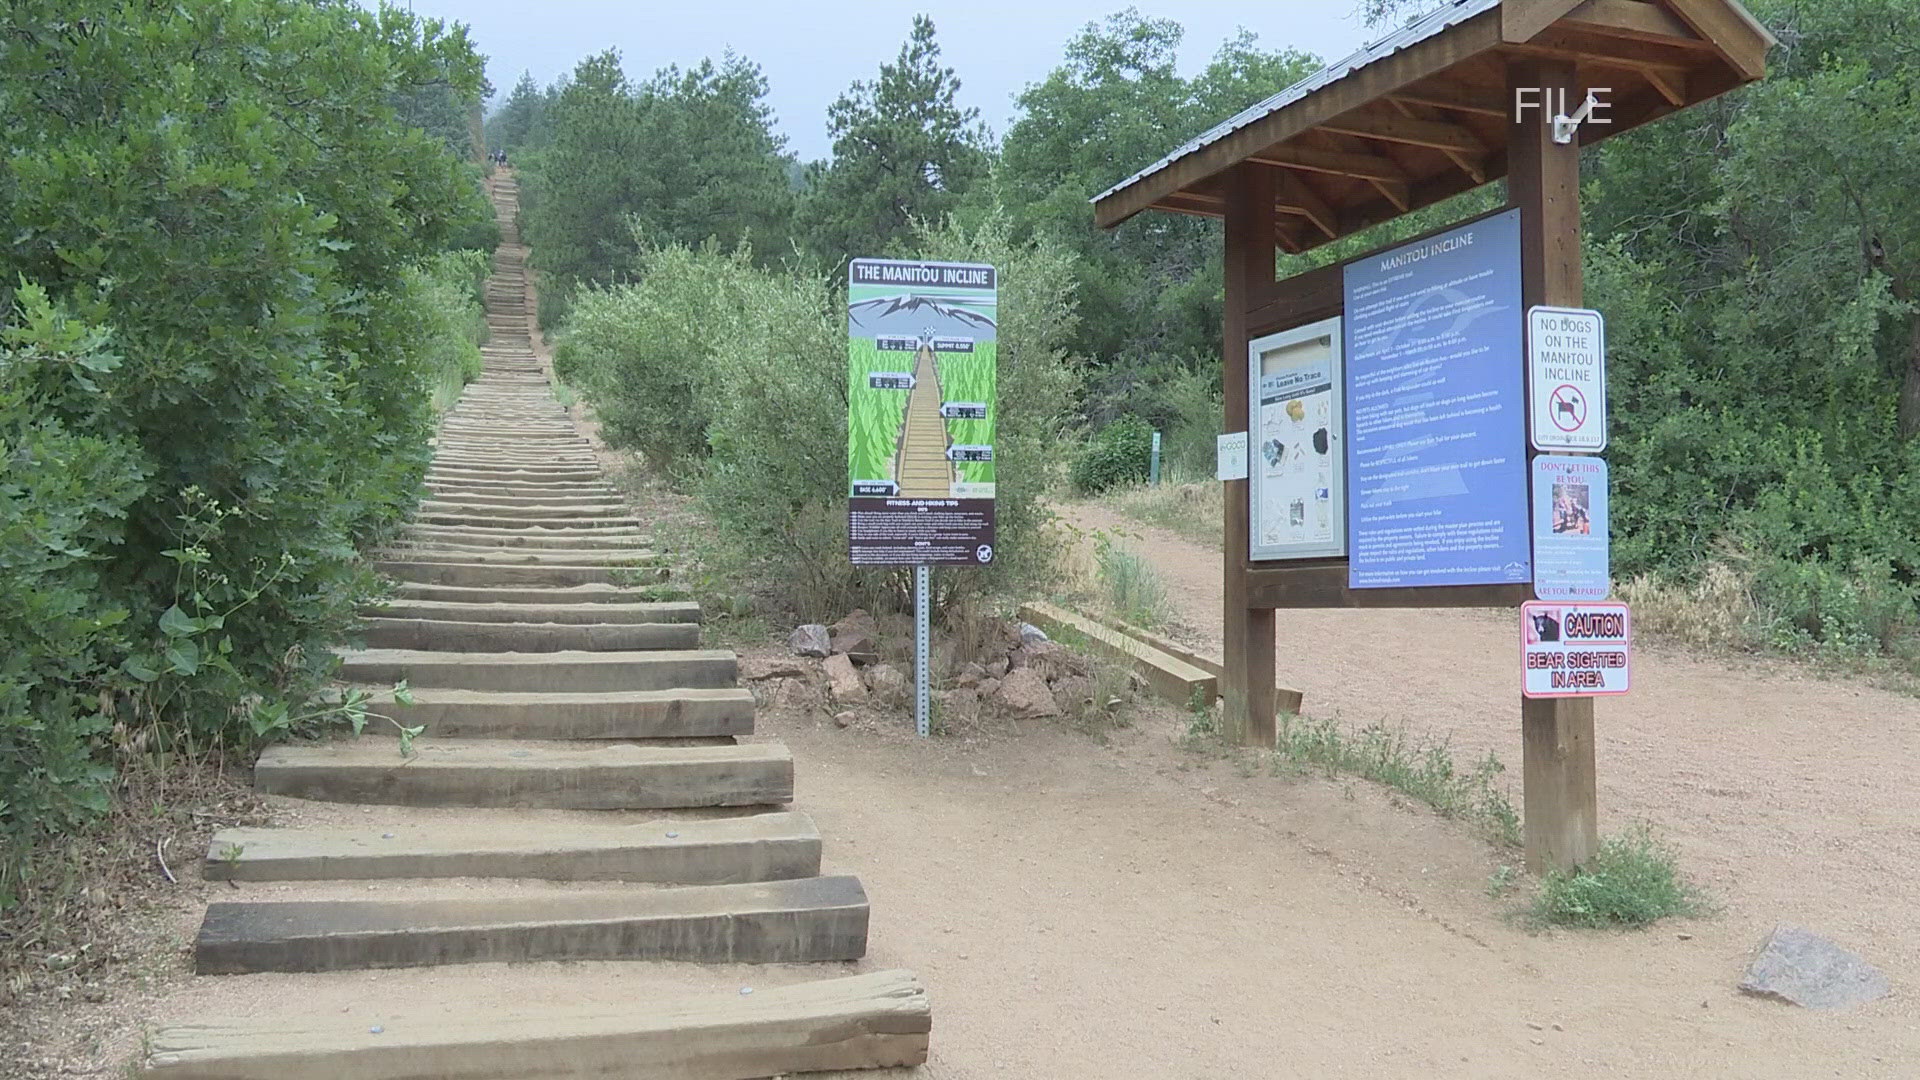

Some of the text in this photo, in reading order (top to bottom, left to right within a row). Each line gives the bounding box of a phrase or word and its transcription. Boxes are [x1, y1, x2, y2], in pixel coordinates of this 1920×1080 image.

[1380, 232, 1474, 272] MANITOU INCLINE
[857, 265, 988, 284] THE MANITOU INCLINE
[1540, 320, 1592, 333] NO DOGS
[1545, 335, 1588, 349] ON THE
[1540, 352, 1593, 366] MANITOU
[1276, 379, 1294, 388] Leave
[1304, 372, 1322, 381] Trace
[1545, 368, 1590, 382] INCLINE
[1540, 463, 1566, 471] DON'T
[1582, 464, 1600, 473] THIS
[1566, 476, 1584, 484] YOU
[1565, 613, 1624, 638] CAUTION
[1527, 652, 1626, 669] BEAR SIGHTED
[1551, 671, 1606, 688] IN AREA
